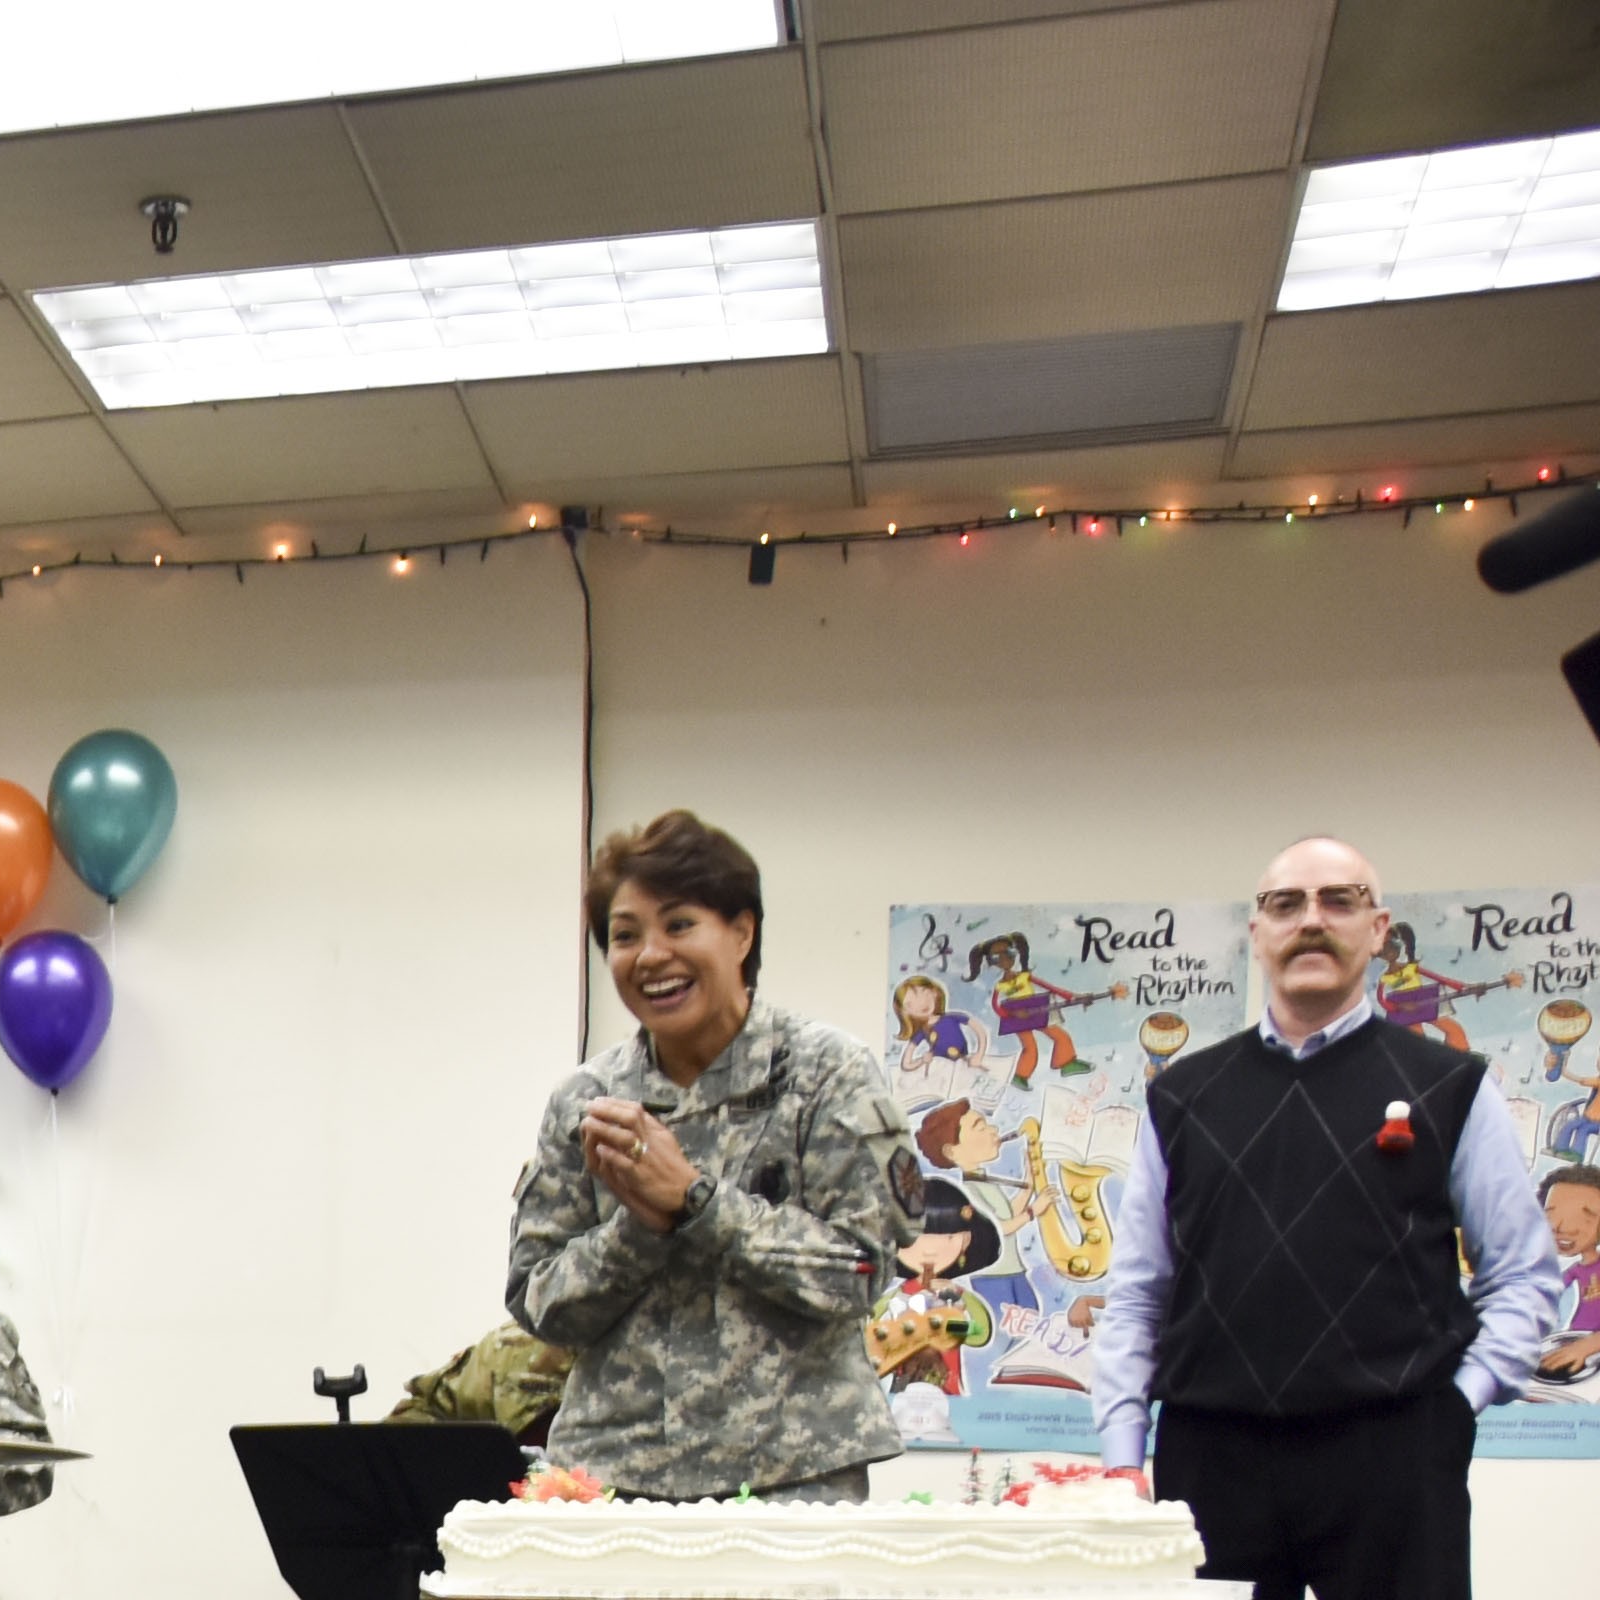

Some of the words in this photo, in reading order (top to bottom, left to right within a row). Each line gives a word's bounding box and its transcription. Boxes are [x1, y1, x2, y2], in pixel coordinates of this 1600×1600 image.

[1074, 908, 1176, 963] Read
[1463, 892, 1575, 951] Read
[1150, 952, 1172, 972] to
[1175, 951, 1208, 971] the
[1547, 940, 1571, 958] to
[1133, 973, 1235, 1006] Rhythm
